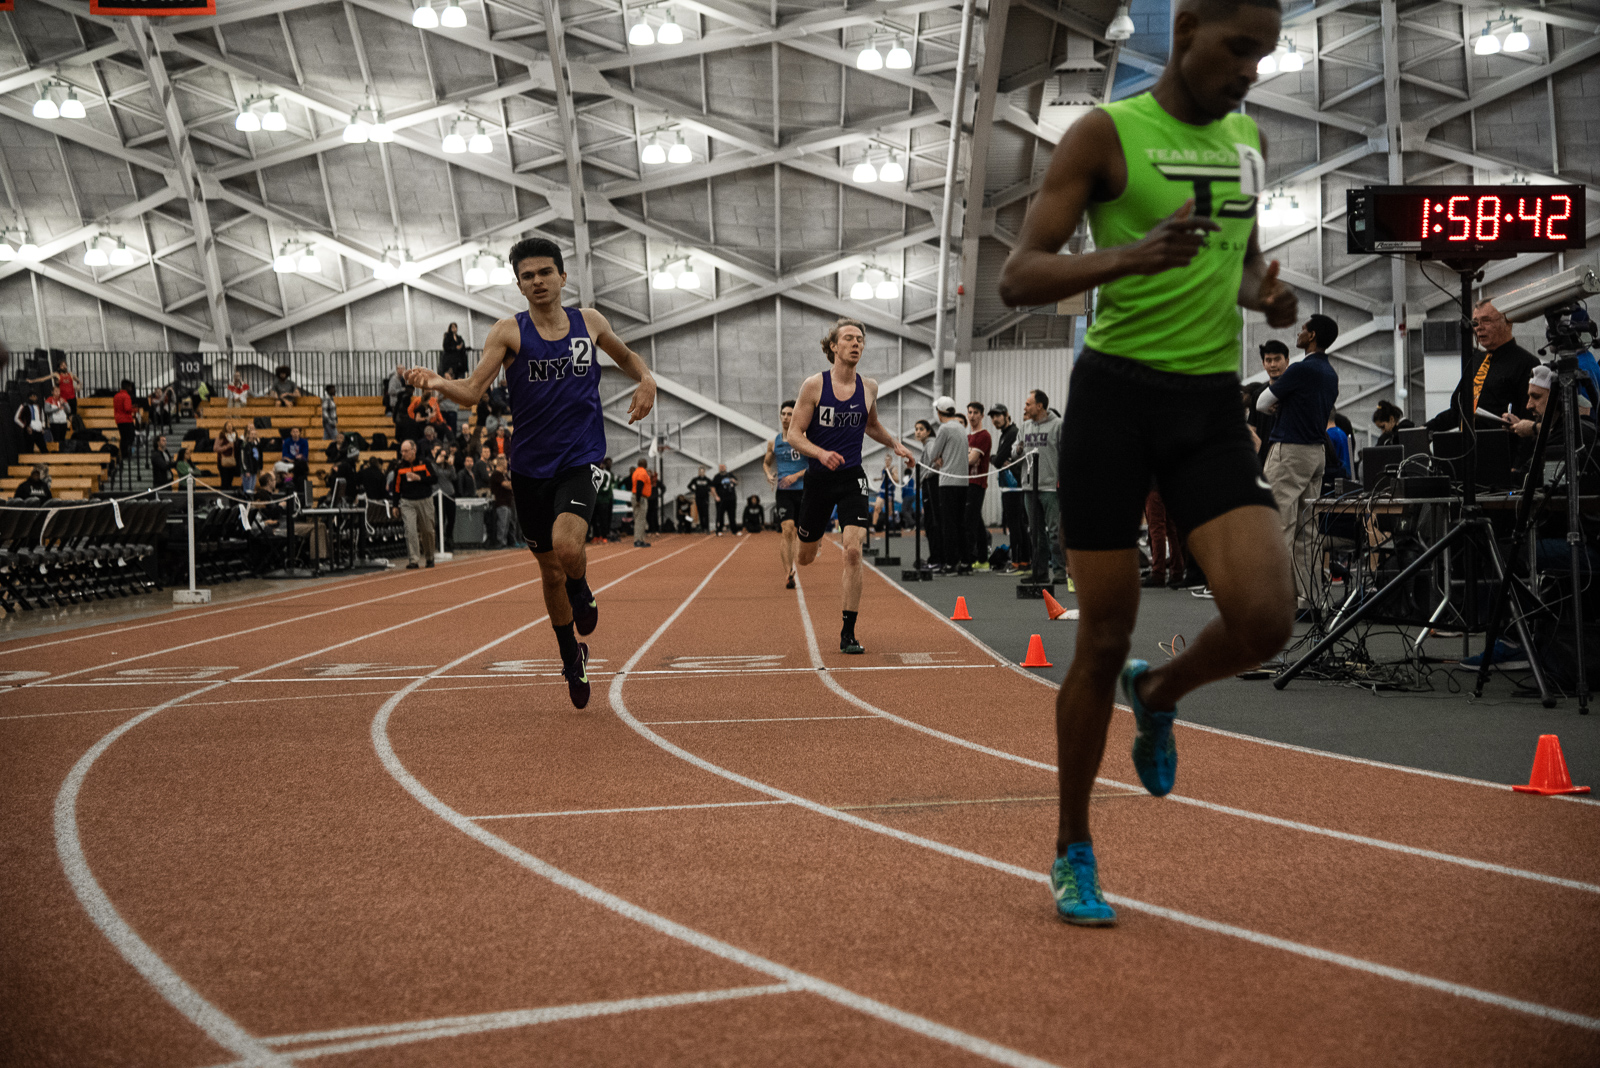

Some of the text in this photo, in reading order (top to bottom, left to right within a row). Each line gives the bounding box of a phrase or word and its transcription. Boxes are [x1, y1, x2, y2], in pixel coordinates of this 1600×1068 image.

[1145, 148, 1198, 162] TEAM
[1245, 150, 1259, 193] 1
[574, 340, 590, 364] 2
[180, 361, 200, 373] 103
[821, 408, 832, 425] 4
[834, 412, 862, 428] YU
[1025, 433, 1049, 442] NYU
[792, 450, 799, 459] 6
